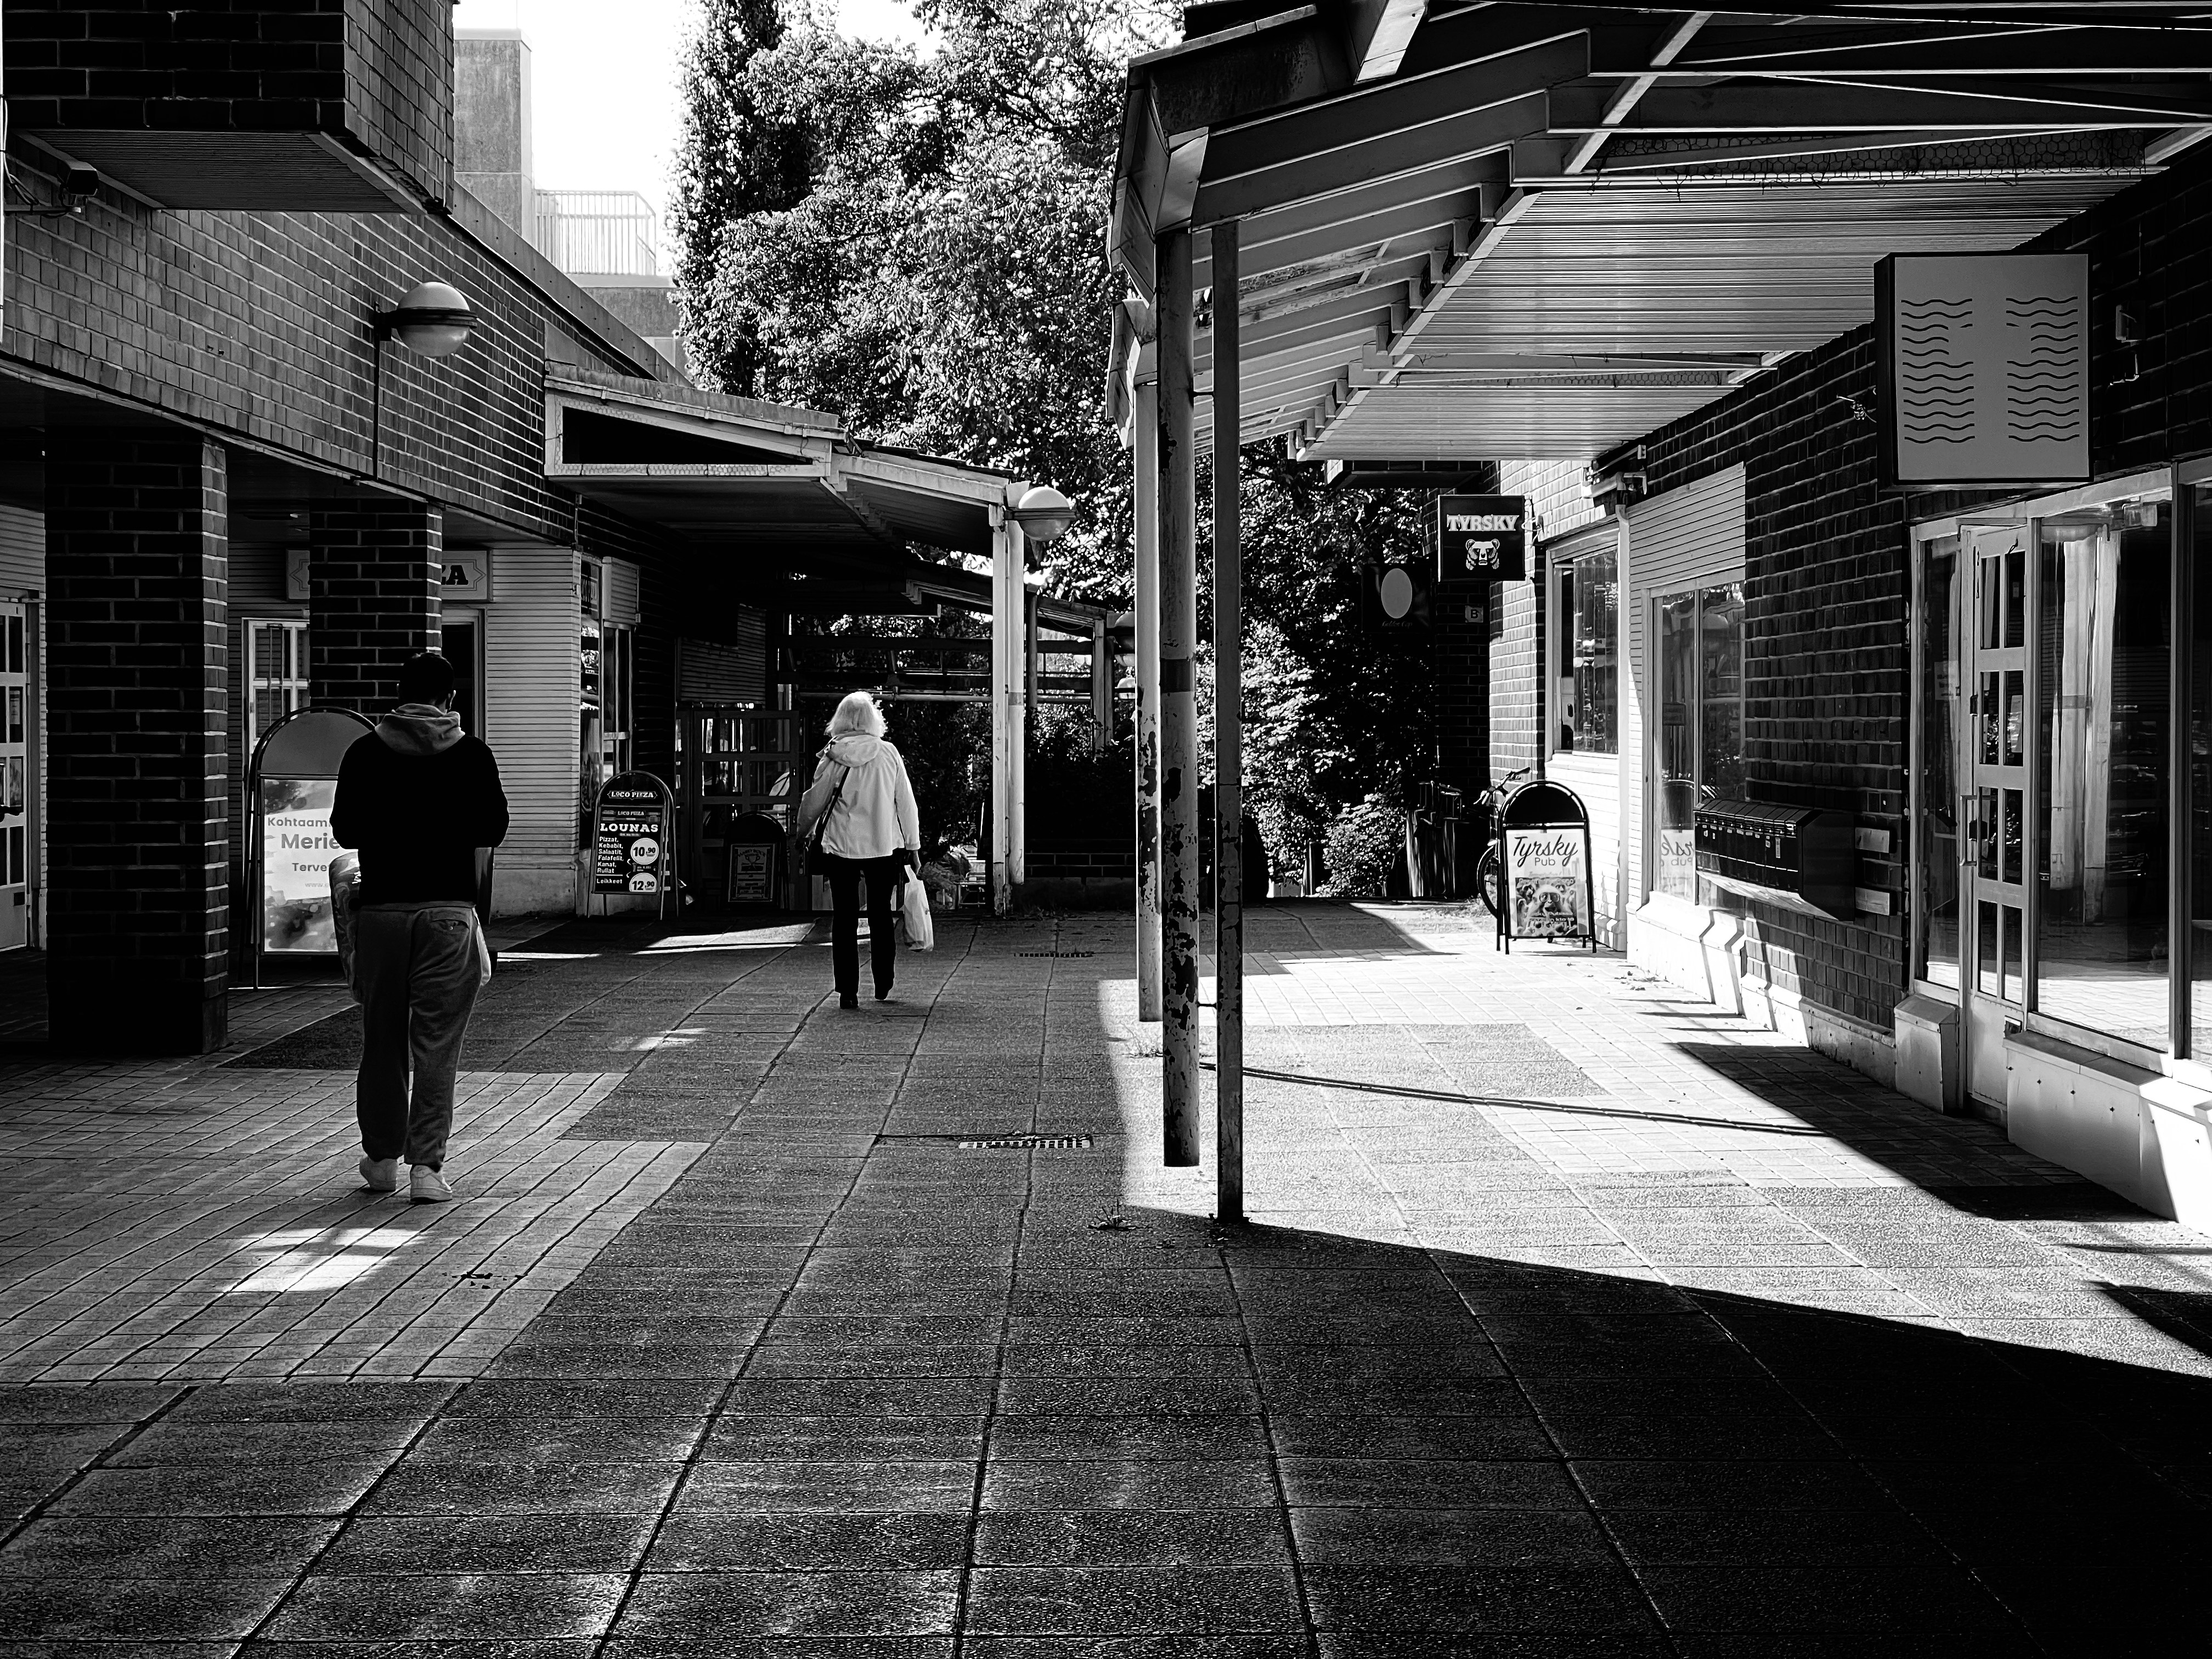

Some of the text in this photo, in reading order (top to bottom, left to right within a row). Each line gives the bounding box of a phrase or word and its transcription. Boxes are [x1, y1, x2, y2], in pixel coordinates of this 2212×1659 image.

[1447, 515, 1519, 531] TYRSKY
[1471, 610, 1478, 618] B
[268, 817, 331, 827] Kohtaam
[600, 823, 658, 832] LOUNAS
[1513, 834, 1578, 868] Tyrsky
[1534, 857, 1556, 866] Pub
[291, 862, 329, 872] Terve
